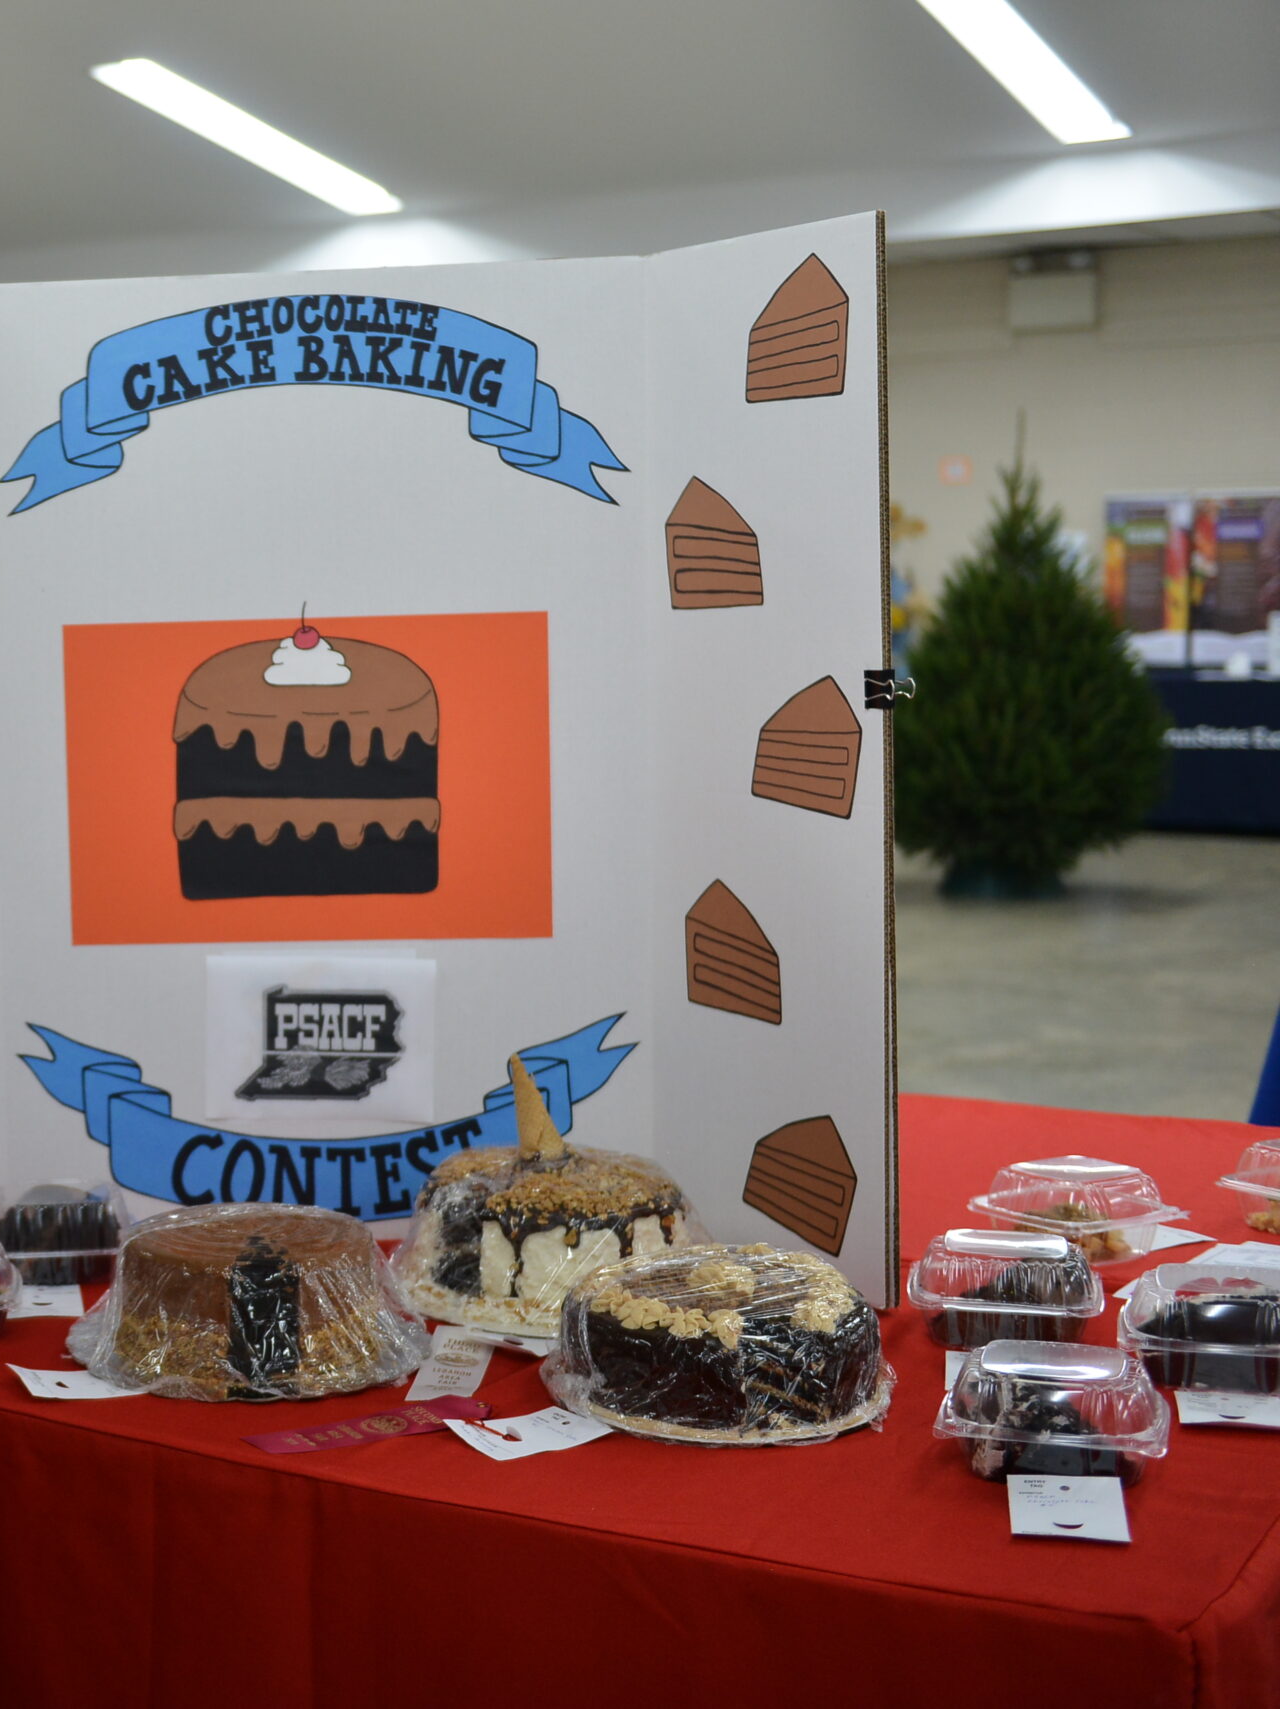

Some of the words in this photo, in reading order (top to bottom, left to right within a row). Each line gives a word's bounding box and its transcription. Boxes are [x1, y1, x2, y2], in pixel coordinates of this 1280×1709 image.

[205, 295, 440, 347] CHOCOLATE
[123, 340, 277, 411] CAKE
[295, 335, 507, 407] BAKING
[274, 1003, 387, 1050] PSACF
